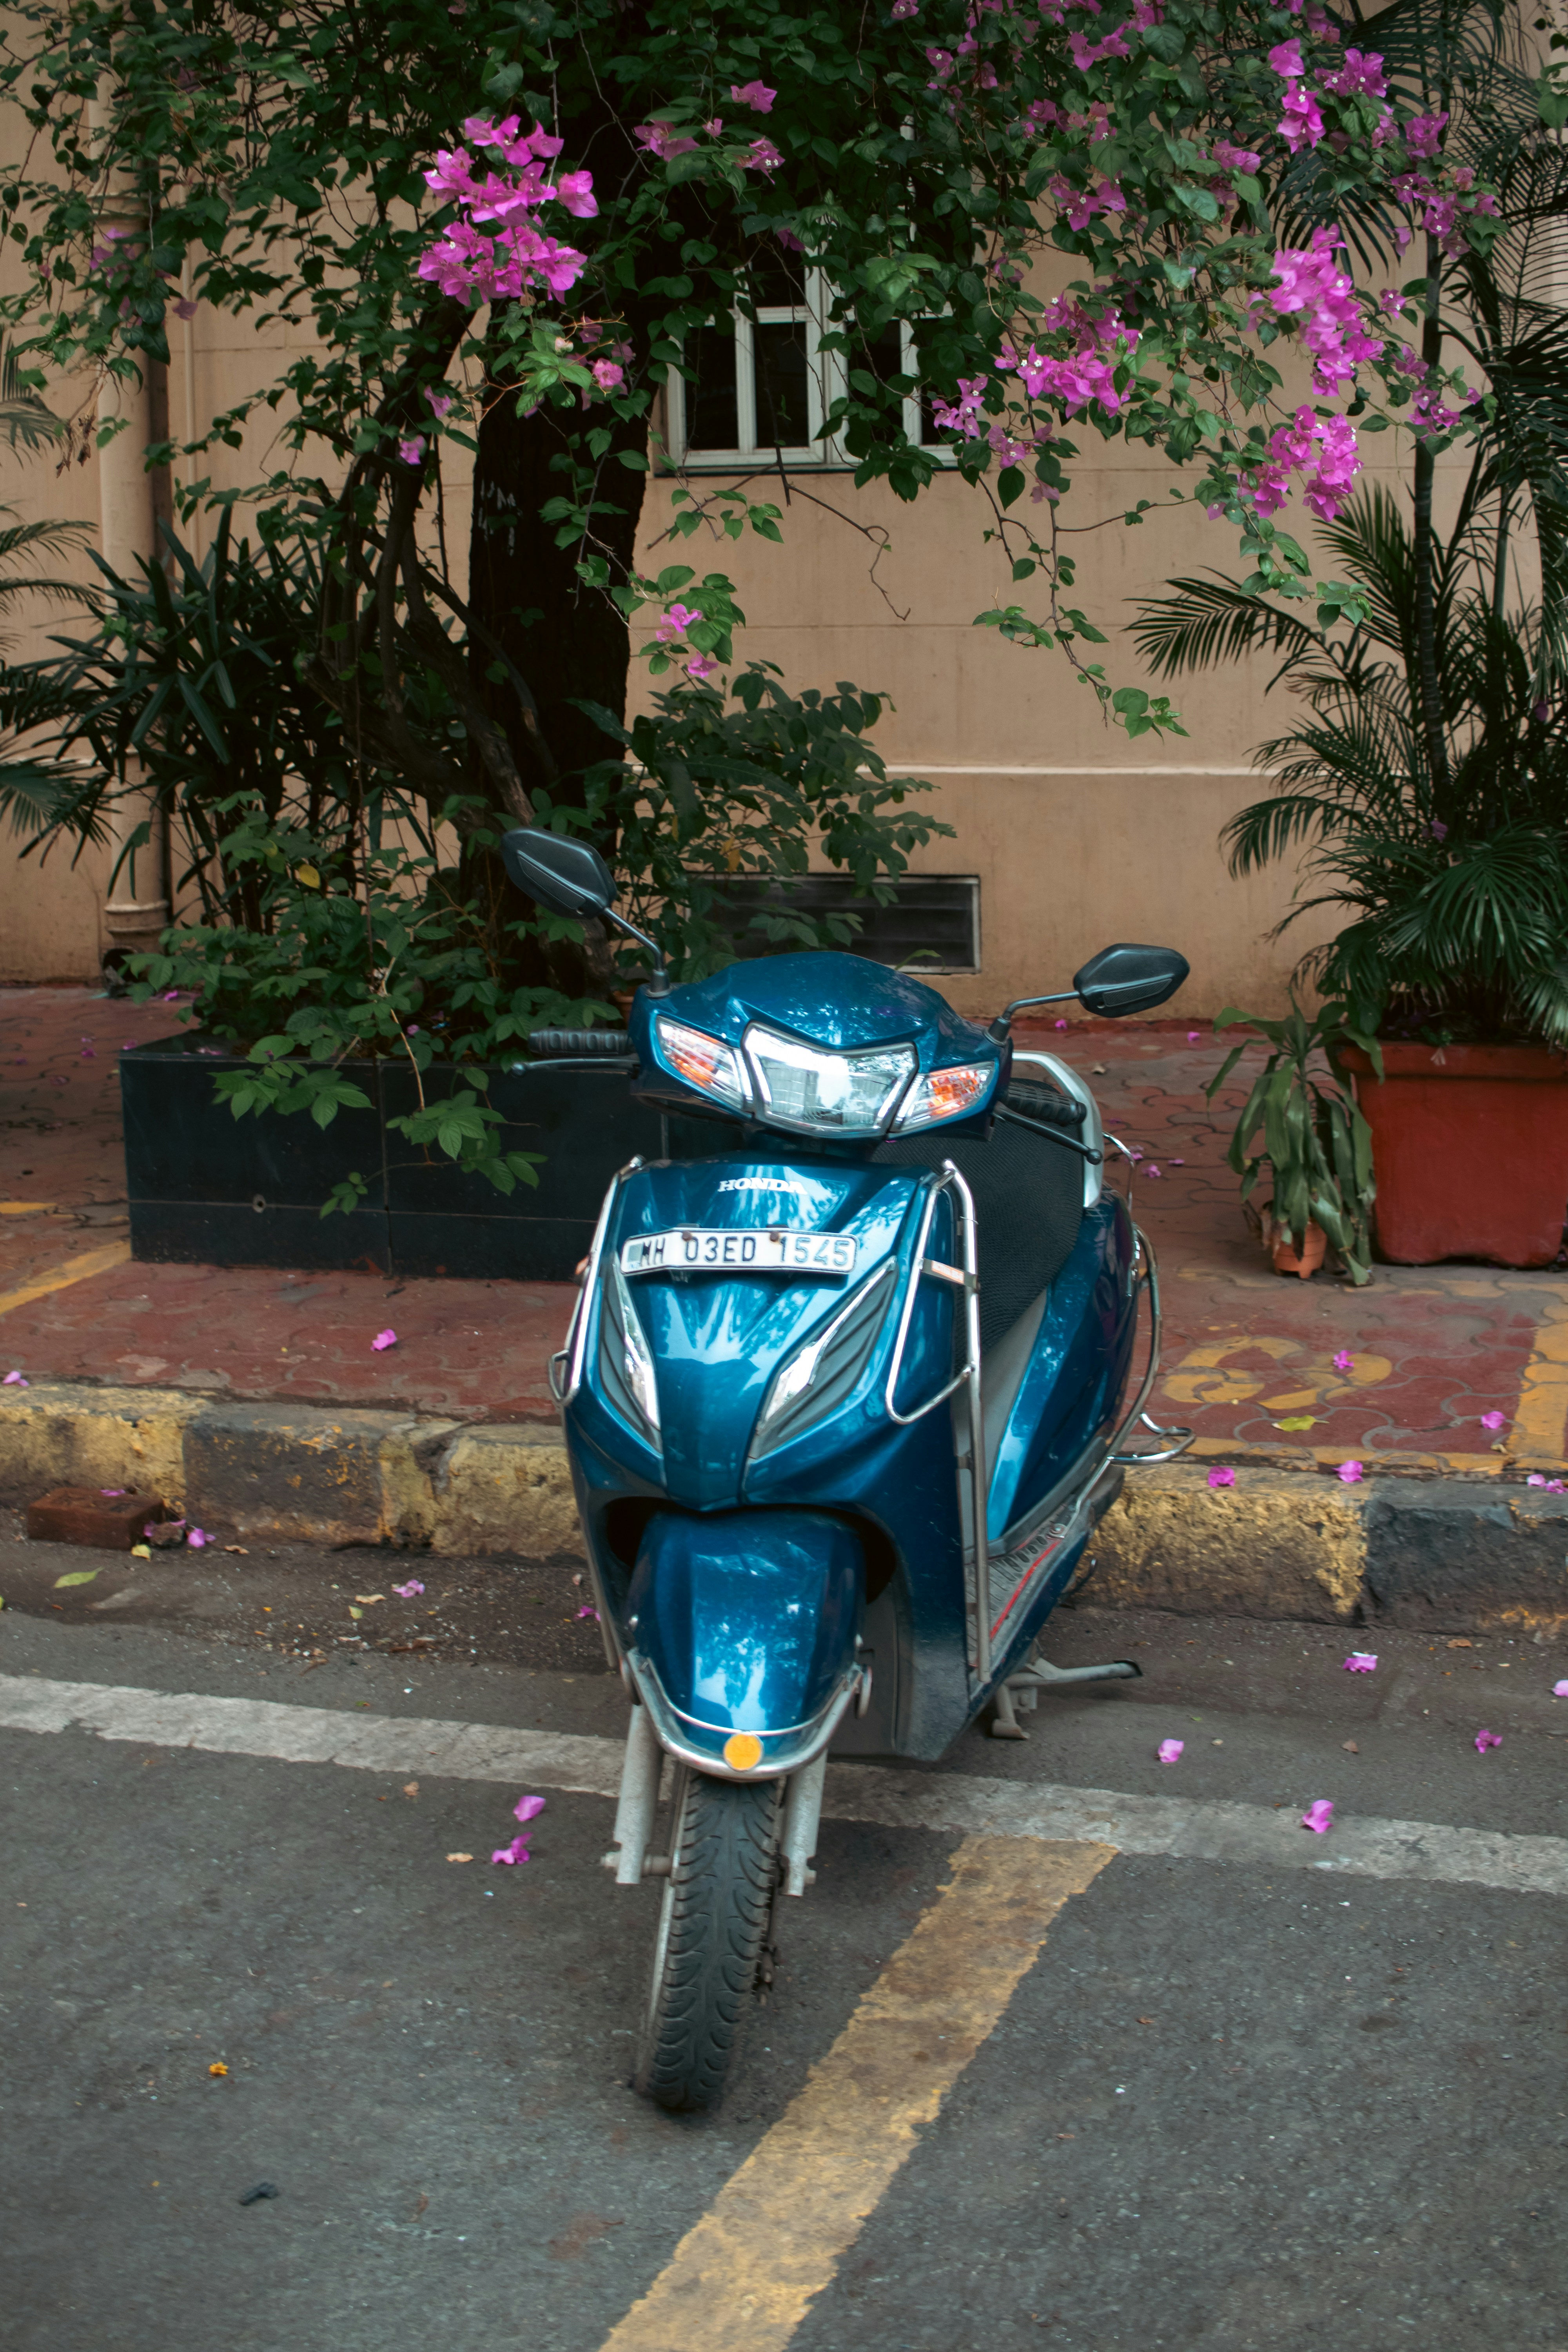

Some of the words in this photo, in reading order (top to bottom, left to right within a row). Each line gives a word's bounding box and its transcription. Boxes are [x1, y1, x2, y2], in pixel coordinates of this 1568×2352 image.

[717, 1177, 808, 1194] HONDA
[640, 1237, 665, 1267] MH
[686, 1236, 756, 1262] 03ED
[779, 1236, 850, 1267] 1545
